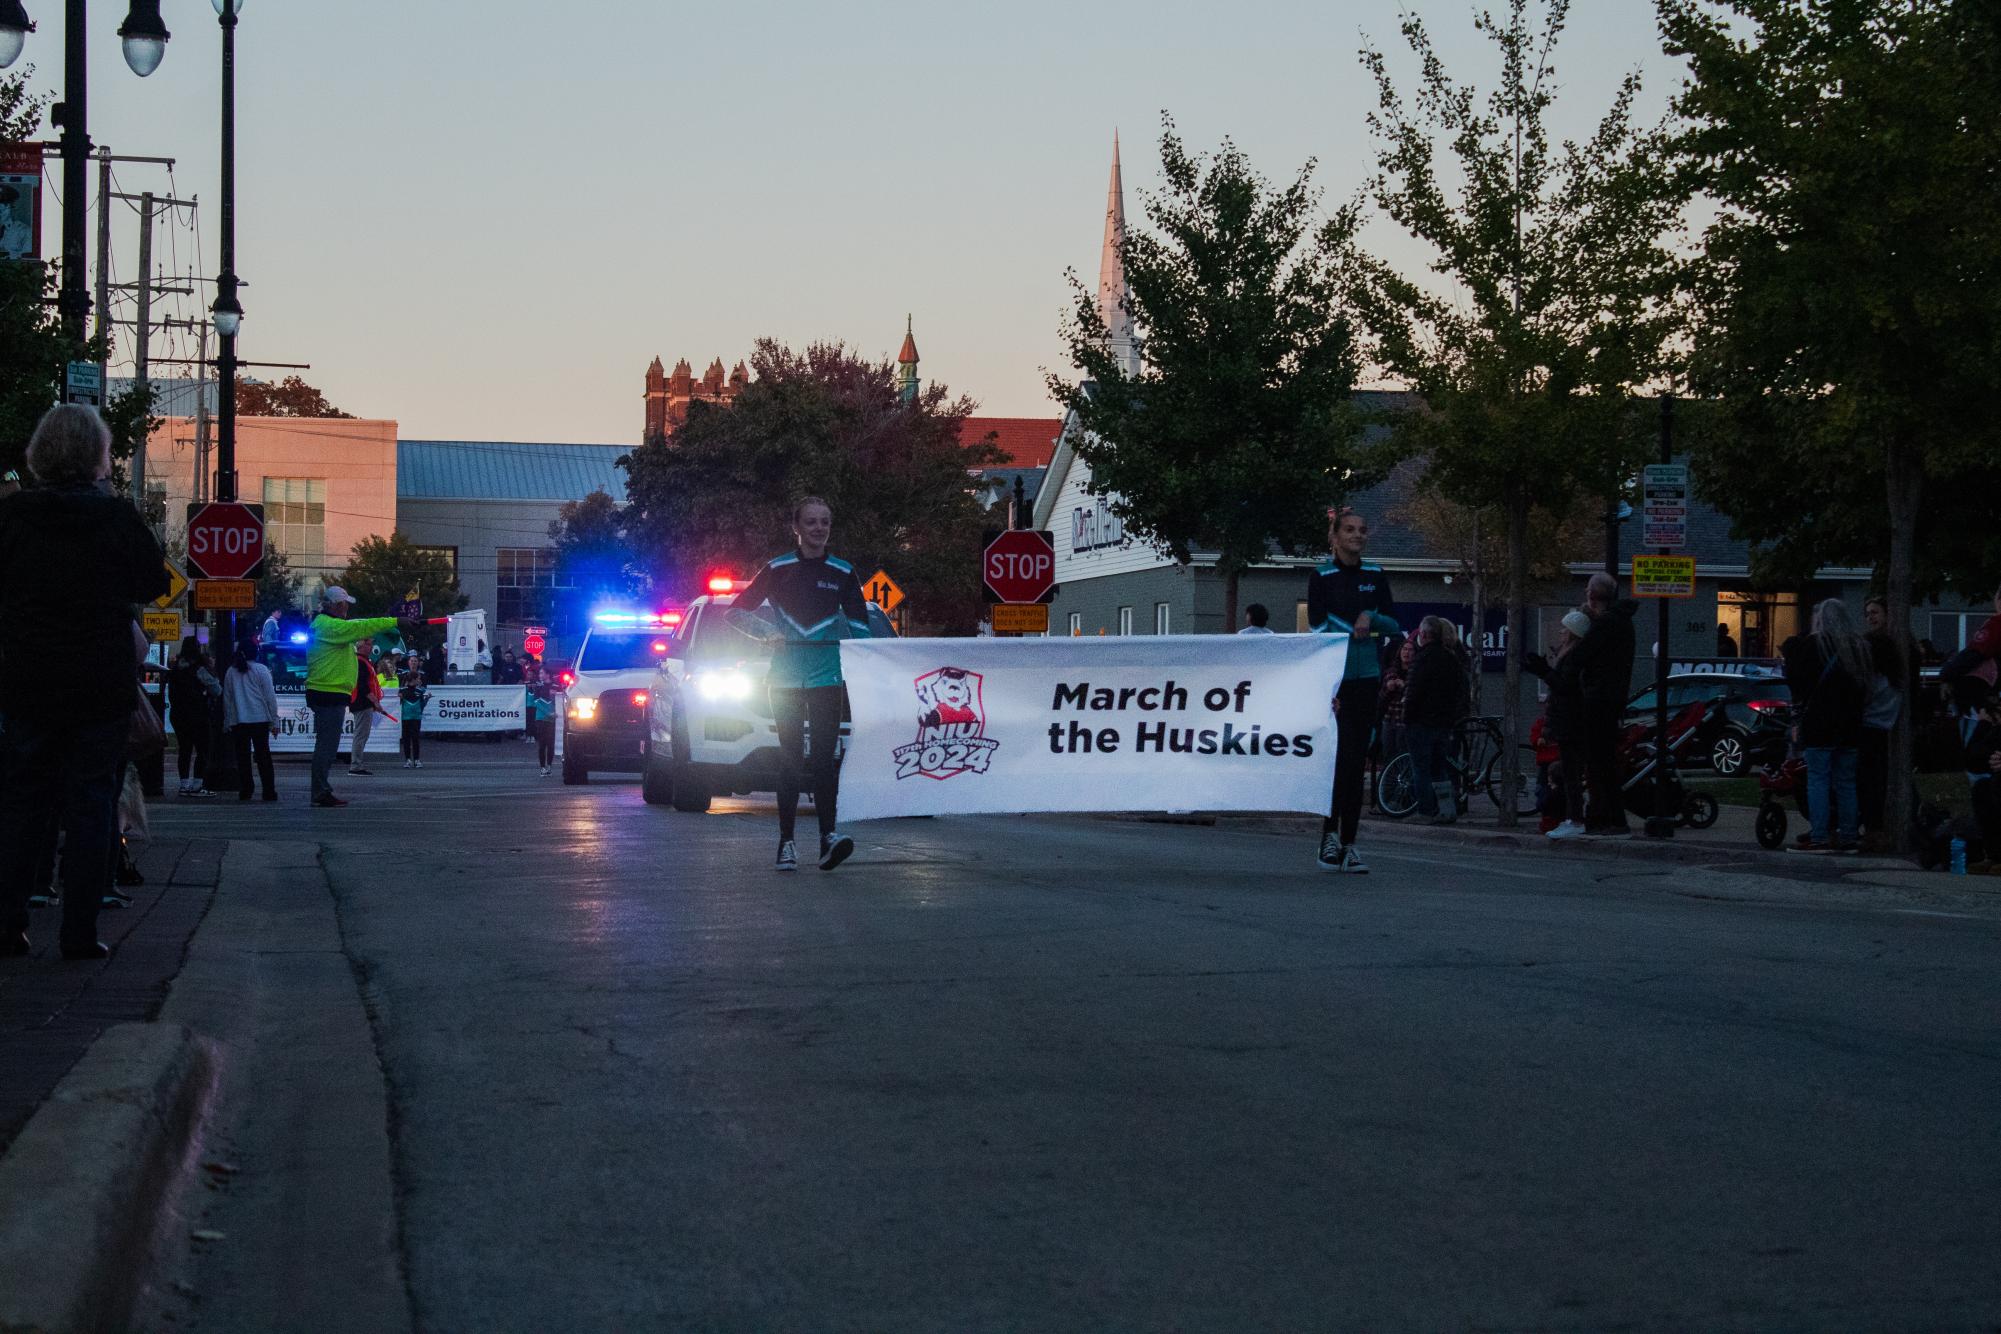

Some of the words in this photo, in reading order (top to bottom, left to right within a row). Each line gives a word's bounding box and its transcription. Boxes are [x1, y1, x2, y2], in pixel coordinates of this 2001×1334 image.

[192, 526, 259, 554] STOP
[989, 553, 1051, 580] STOP
[1636, 560, 1650, 568] NO
[1652, 560, 1690, 568] PARKING
[1636, 574, 1651, 582] TOW
[1673, 575, 1692, 583] ZONE
[146, 617, 161, 625] TWO
[163, 617, 177, 625] WAY
[1685, 622, 1705, 632] 305
[526, 641, 544, 649] STOP
[1052, 681, 1188, 711] March
[1203, 680, 1251, 712] of
[439, 699, 485, 708] Student
[439, 709, 520, 720] Organizations
[922, 720, 981, 742] NIU
[924, 738, 998, 749] HOMECOMING
[1048, 721, 1120, 753] the
[1136, 721, 1314, 757] Huskies
[894, 745, 990, 780] 2024
